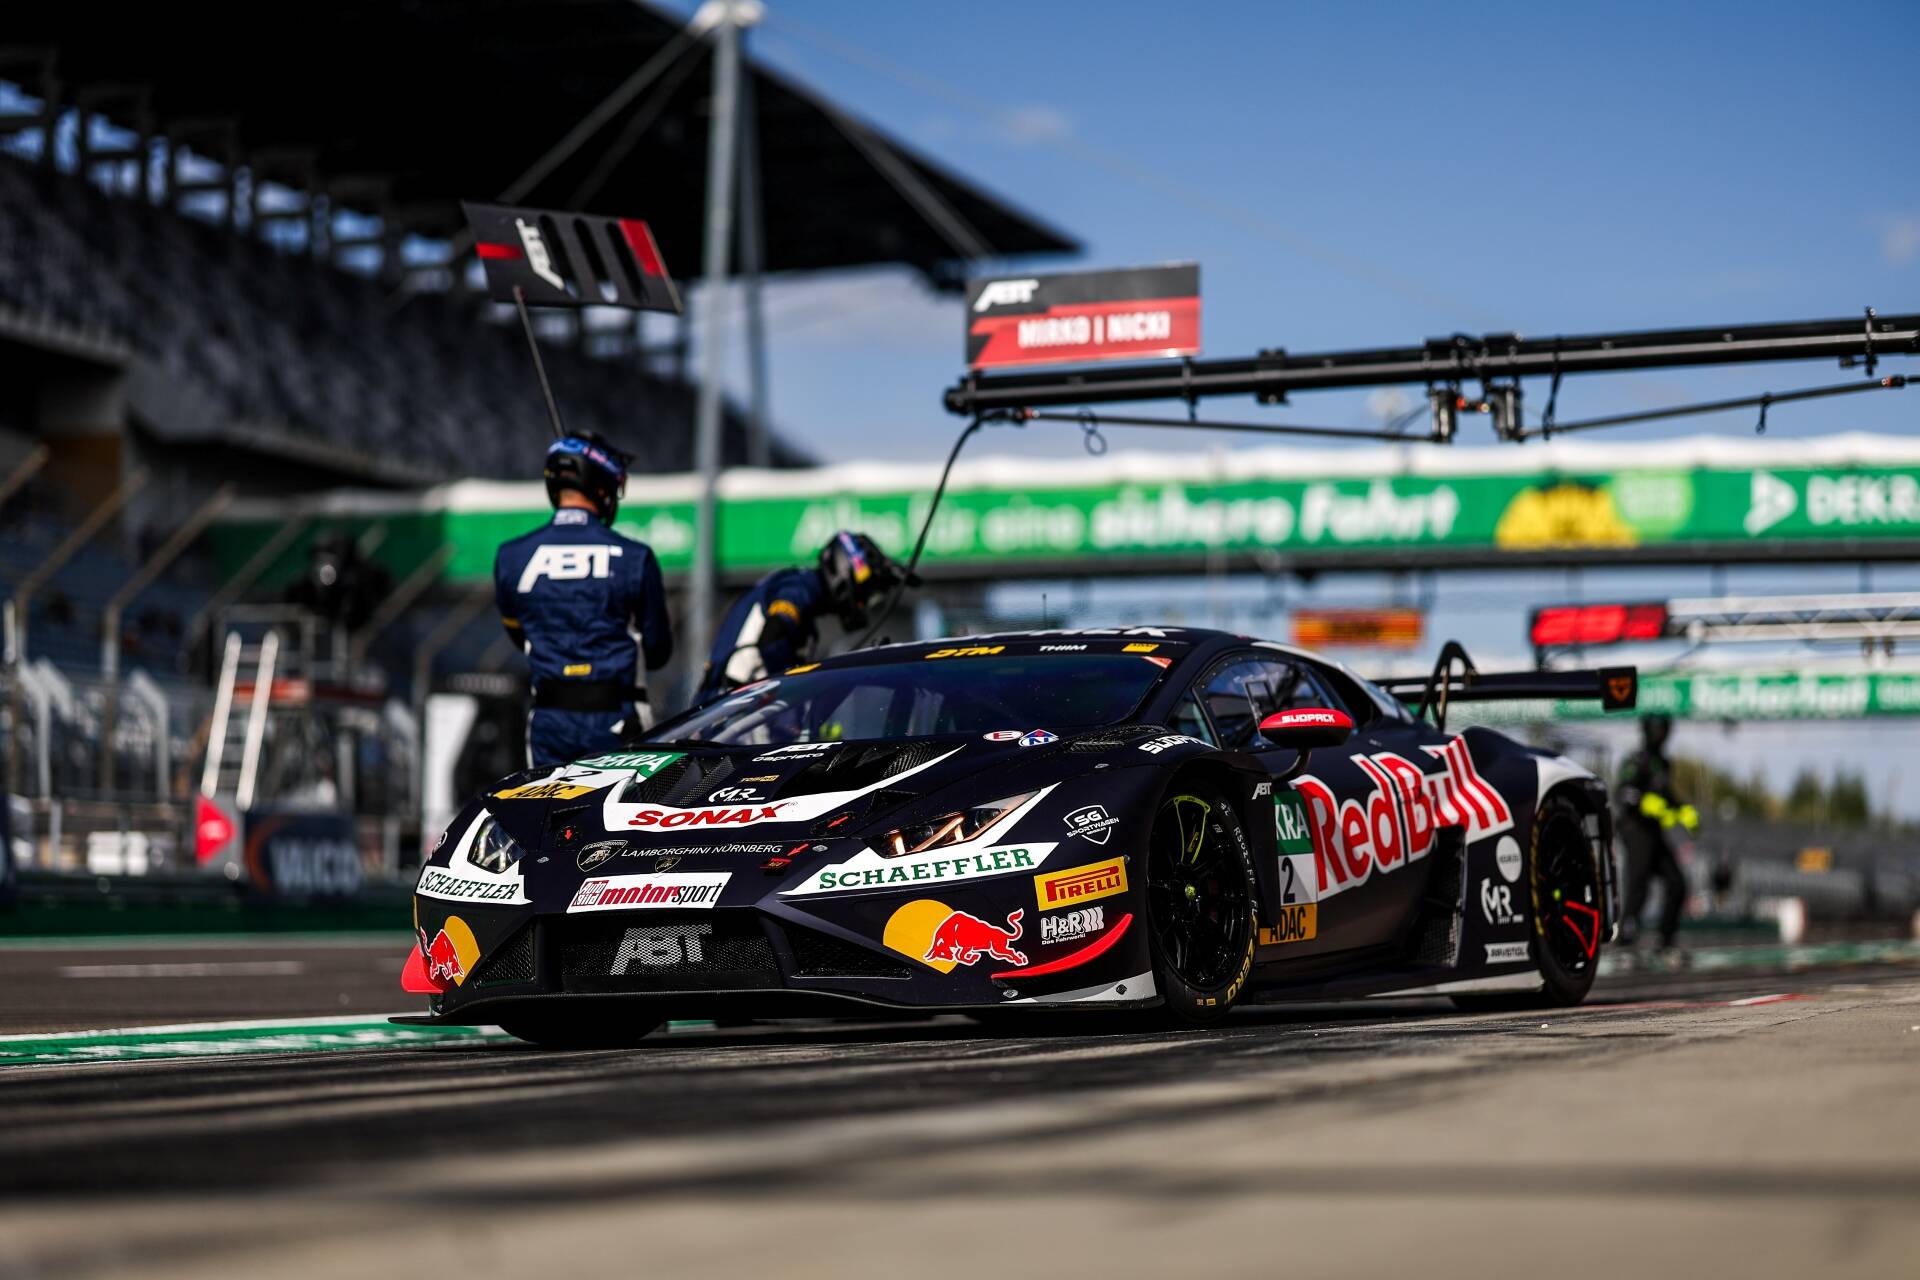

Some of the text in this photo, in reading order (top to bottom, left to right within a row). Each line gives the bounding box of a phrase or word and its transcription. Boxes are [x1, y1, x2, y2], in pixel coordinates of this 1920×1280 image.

[974, 279, 1039, 311] ABT
[1807, 474, 1920, 526] DEKR
[517, 544, 624, 594] ABT
[925, 645, 1006, 659] DTM
[1252, 782, 1272, 800] ABT
[628, 802, 789, 828] SONAX
[1066, 816, 1120, 838] SPORTWAGEN
[1074, 810, 1102, 827] SG
[621, 843, 784, 858] LAMBORGHINI NÜRNBERG
[819, 848, 1035, 890] SCHAEFFLER
[1281, 857, 1296, 904] 2
[419, 871, 520, 900] SCHAEFFLER
[1045, 865, 1121, 903] PIRELLI
[1041, 911, 1085, 940] H&R
[610, 923, 712, 976] ABT
